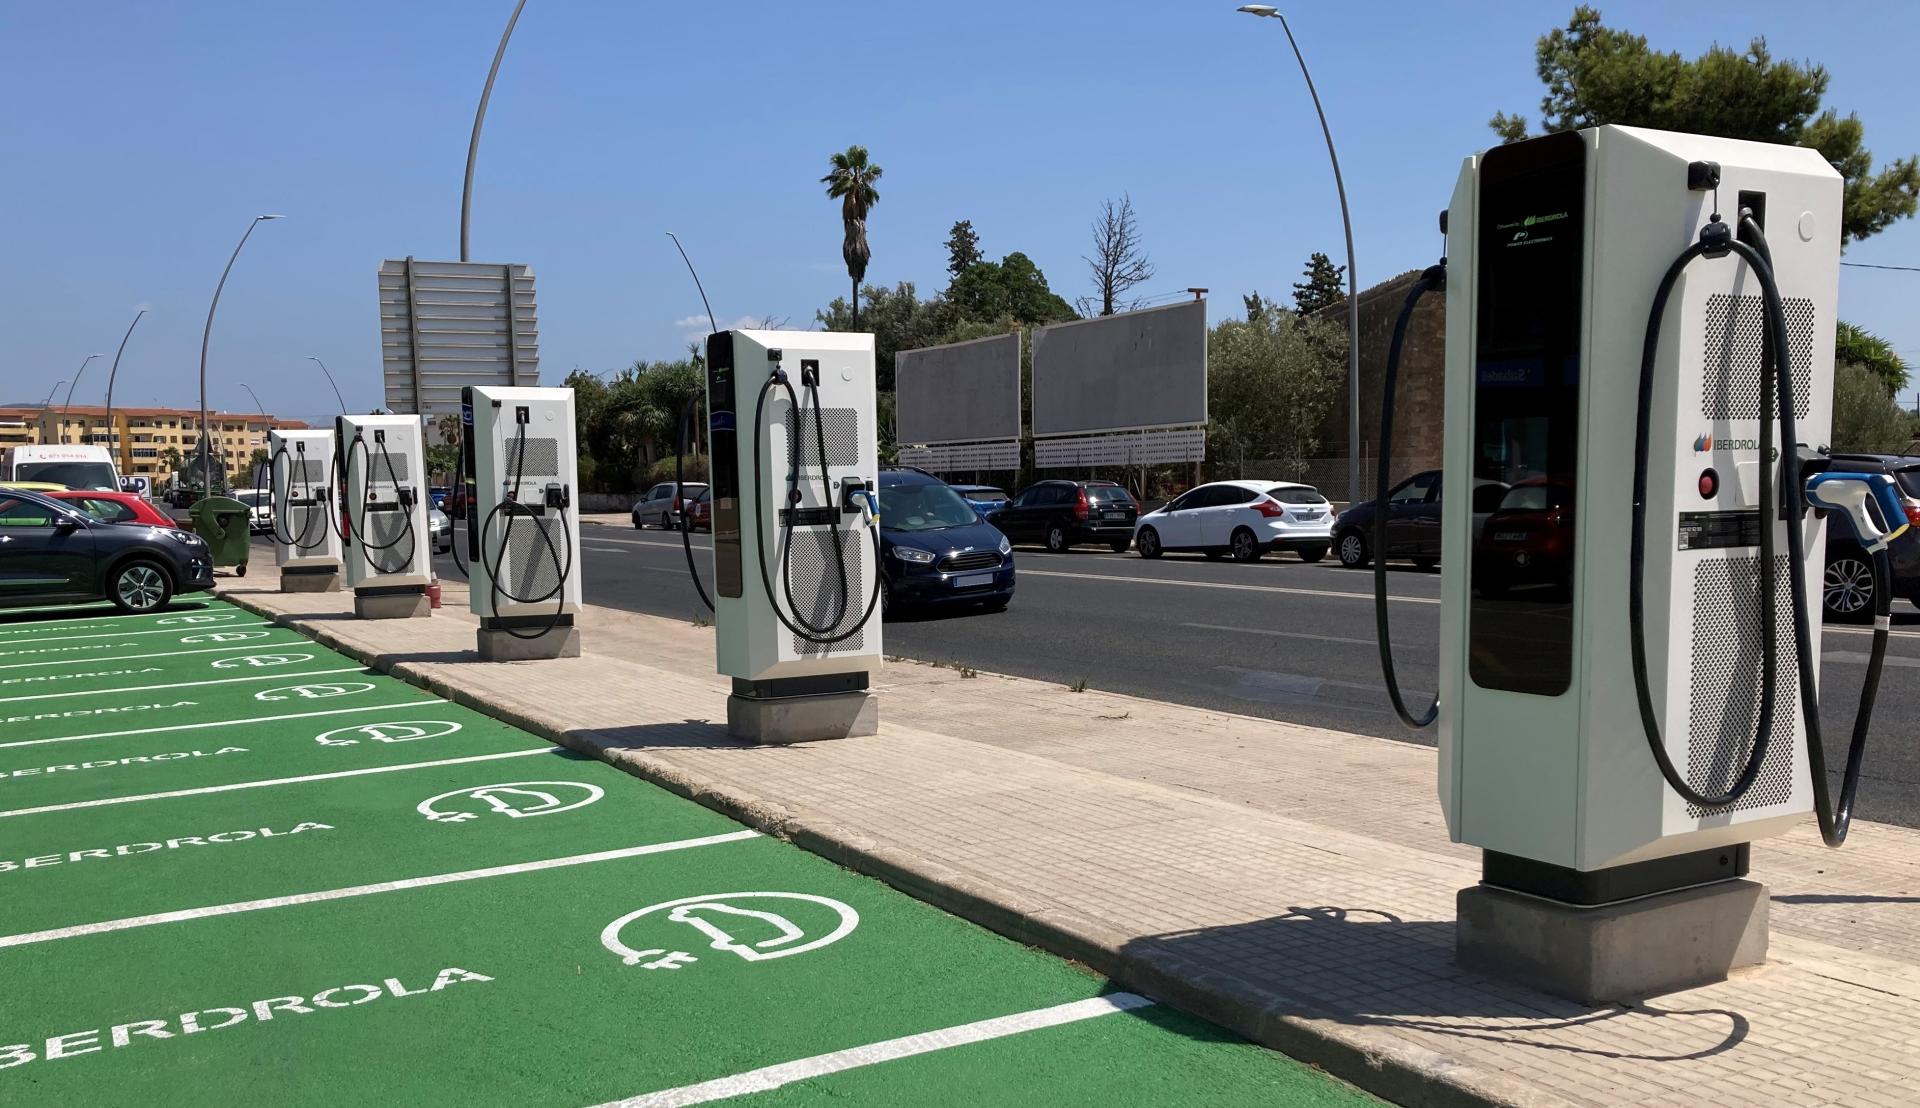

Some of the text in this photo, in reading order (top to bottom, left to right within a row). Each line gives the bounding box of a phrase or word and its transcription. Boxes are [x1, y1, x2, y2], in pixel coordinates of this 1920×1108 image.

[1713, 439, 1760, 451] IBERDROL
[0, 701, 200, 723] ERDROLA
[0, 746, 250, 779] ERDROLA
